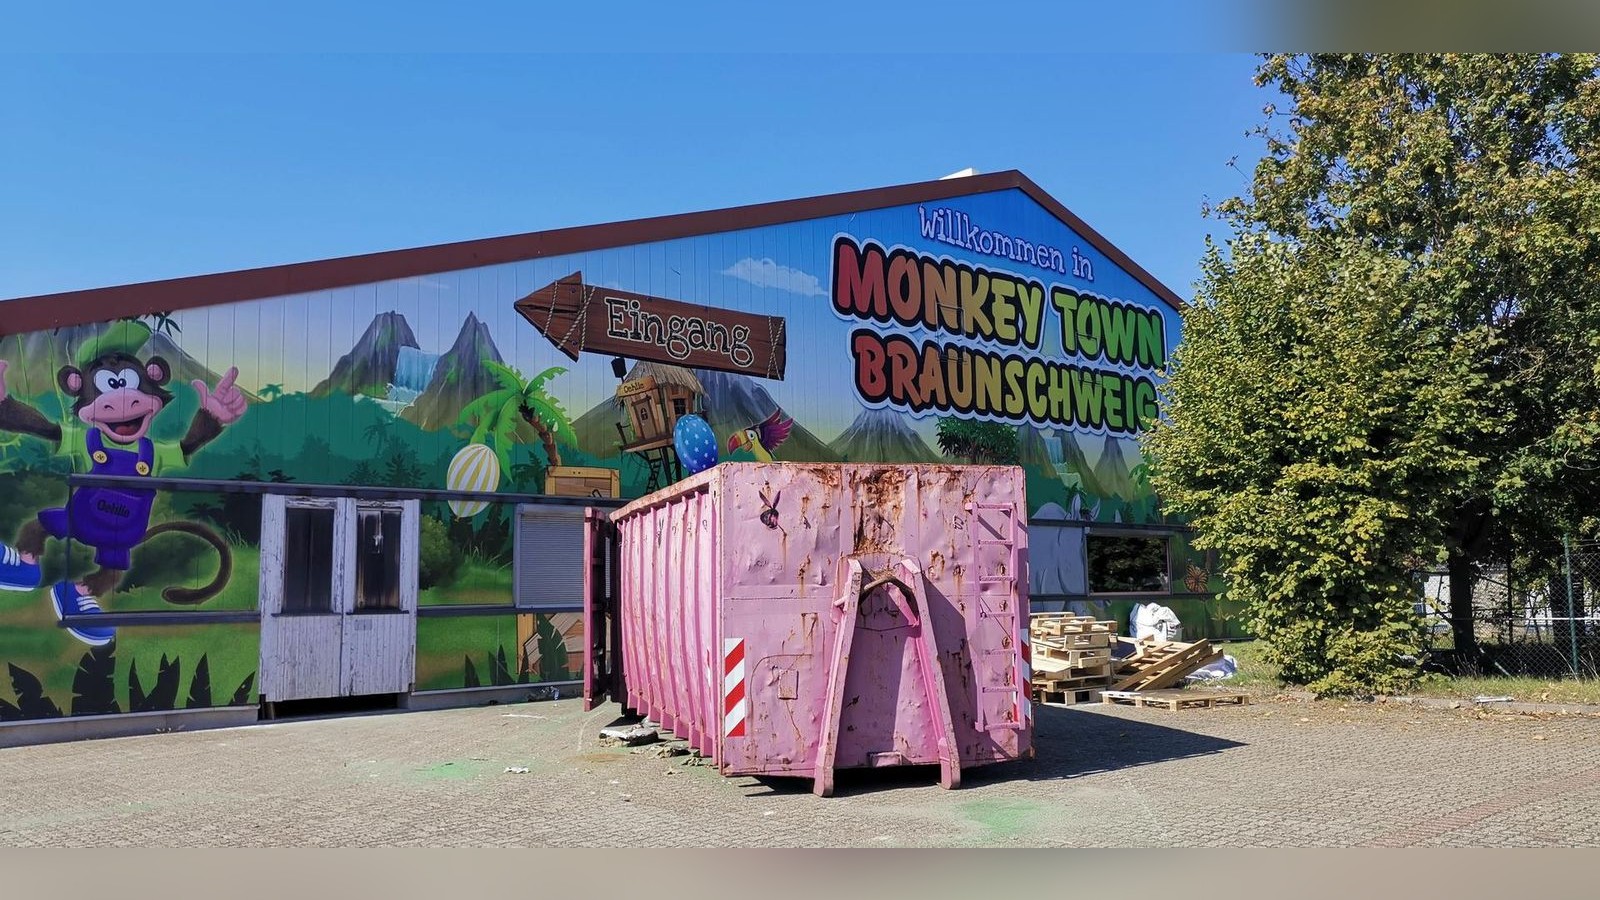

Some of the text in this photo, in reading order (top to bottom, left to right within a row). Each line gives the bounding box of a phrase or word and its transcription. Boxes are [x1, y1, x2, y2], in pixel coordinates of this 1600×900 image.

[919, 204, 1094, 281] Willkommen in
[604, 297, 754, 367] Eingang
[833, 238, 1166, 371] MONKEY TOWN
[853, 330, 1159, 433] BRAUNSCHWEIG
